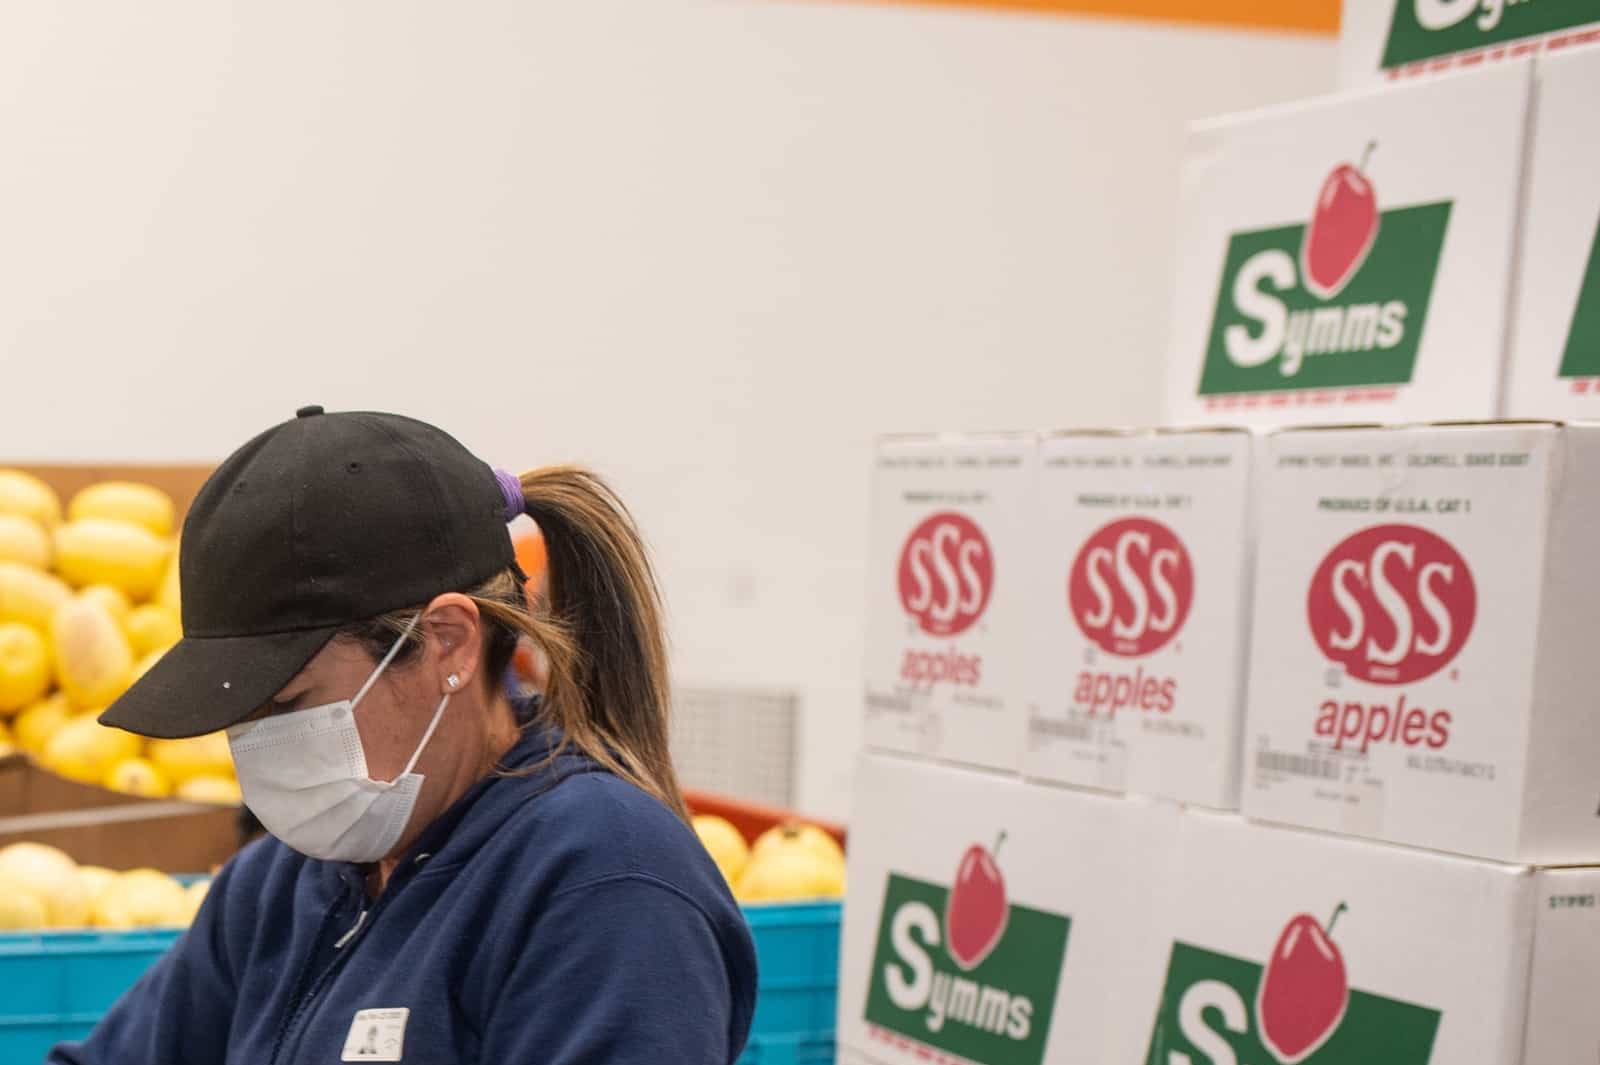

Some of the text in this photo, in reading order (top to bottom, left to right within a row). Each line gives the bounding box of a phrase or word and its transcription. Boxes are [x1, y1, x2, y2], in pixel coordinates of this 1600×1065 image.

[1224, 248, 1408, 378] Symms
[909, 523, 983, 620] SSS
[1084, 531, 1178, 640] SSS
[1329, 541, 1454, 665] SSS
[900, 645, 981, 687] apples
[1073, 666, 1177, 719] apples
[1314, 693, 1453, 754] apples
[884, 901, 1034, 1040] Symms
